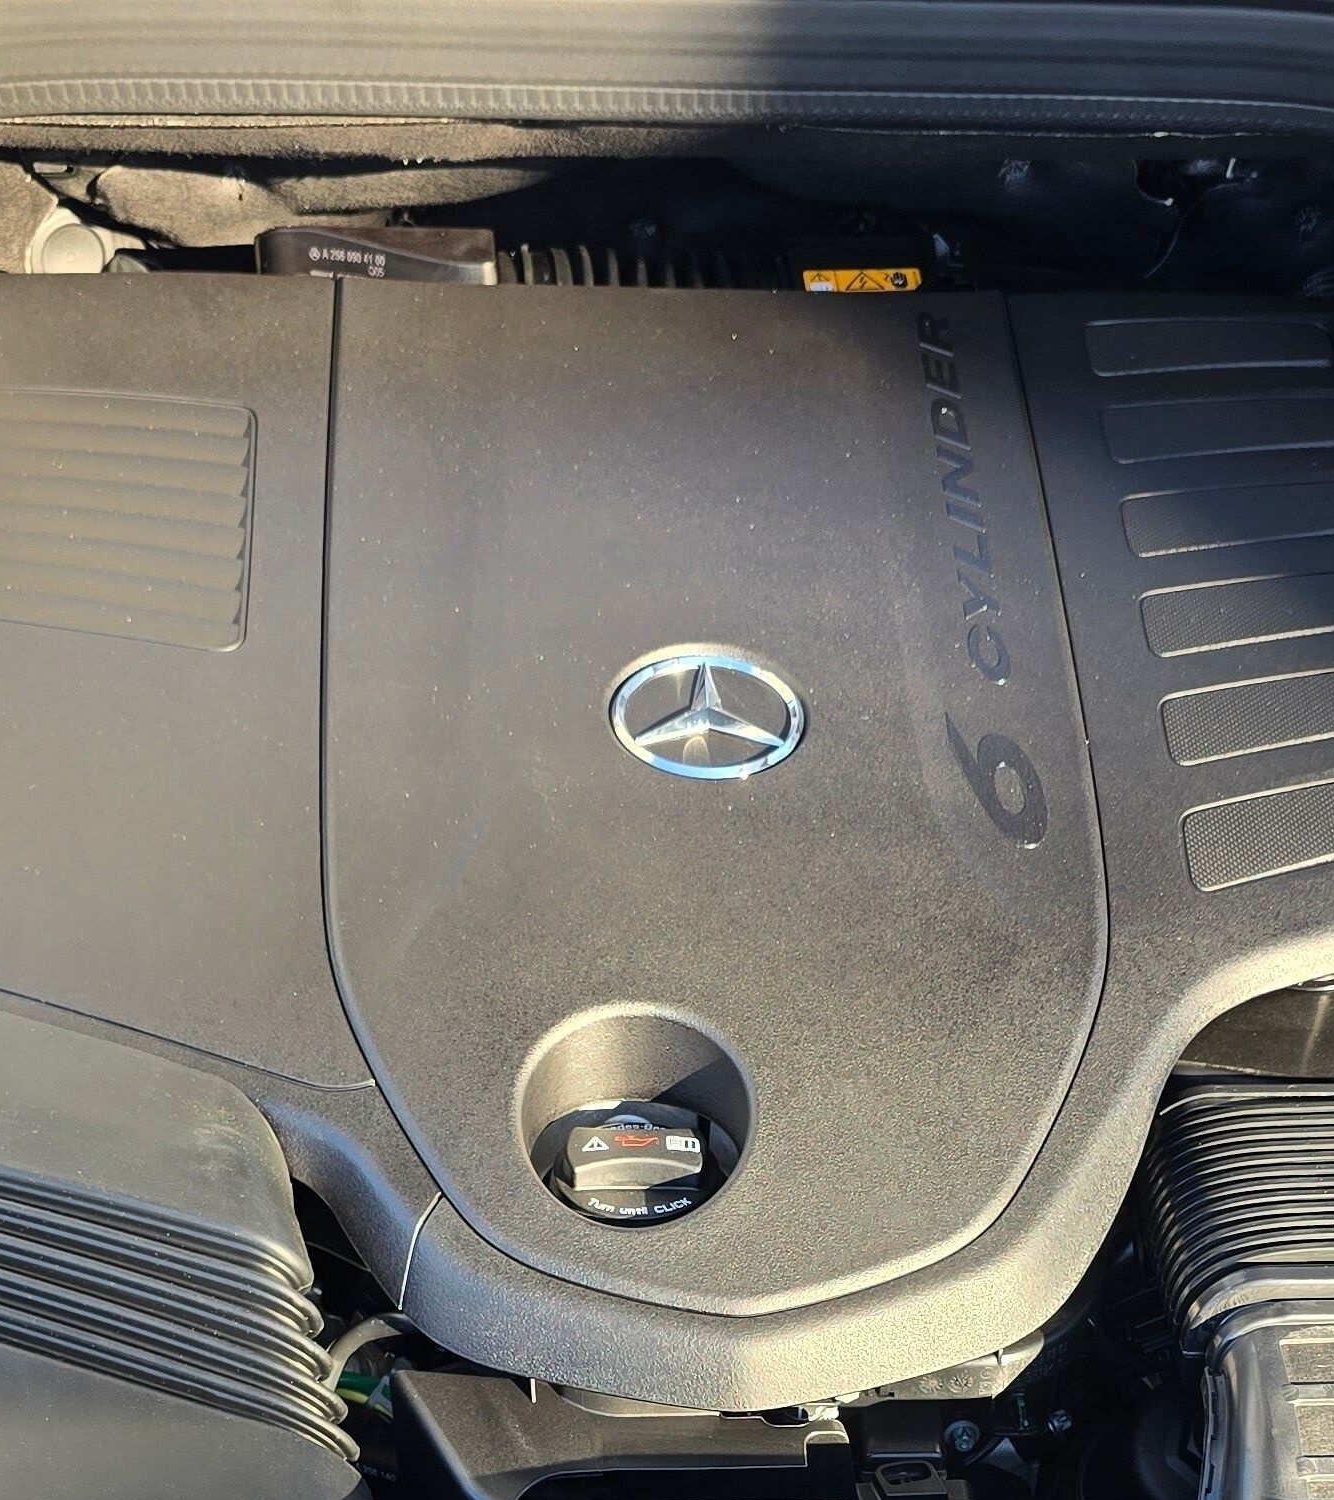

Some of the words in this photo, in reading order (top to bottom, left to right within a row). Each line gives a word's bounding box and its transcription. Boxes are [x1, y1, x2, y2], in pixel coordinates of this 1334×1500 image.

[917, 311, 1012, 686] CYLINDER
[945, 711, 1048, 850] 6
[588, 1198, 616, 1213] Turn
[619, 1206, 649, 1216] until
[654, 1197, 692, 1214] CLICK
